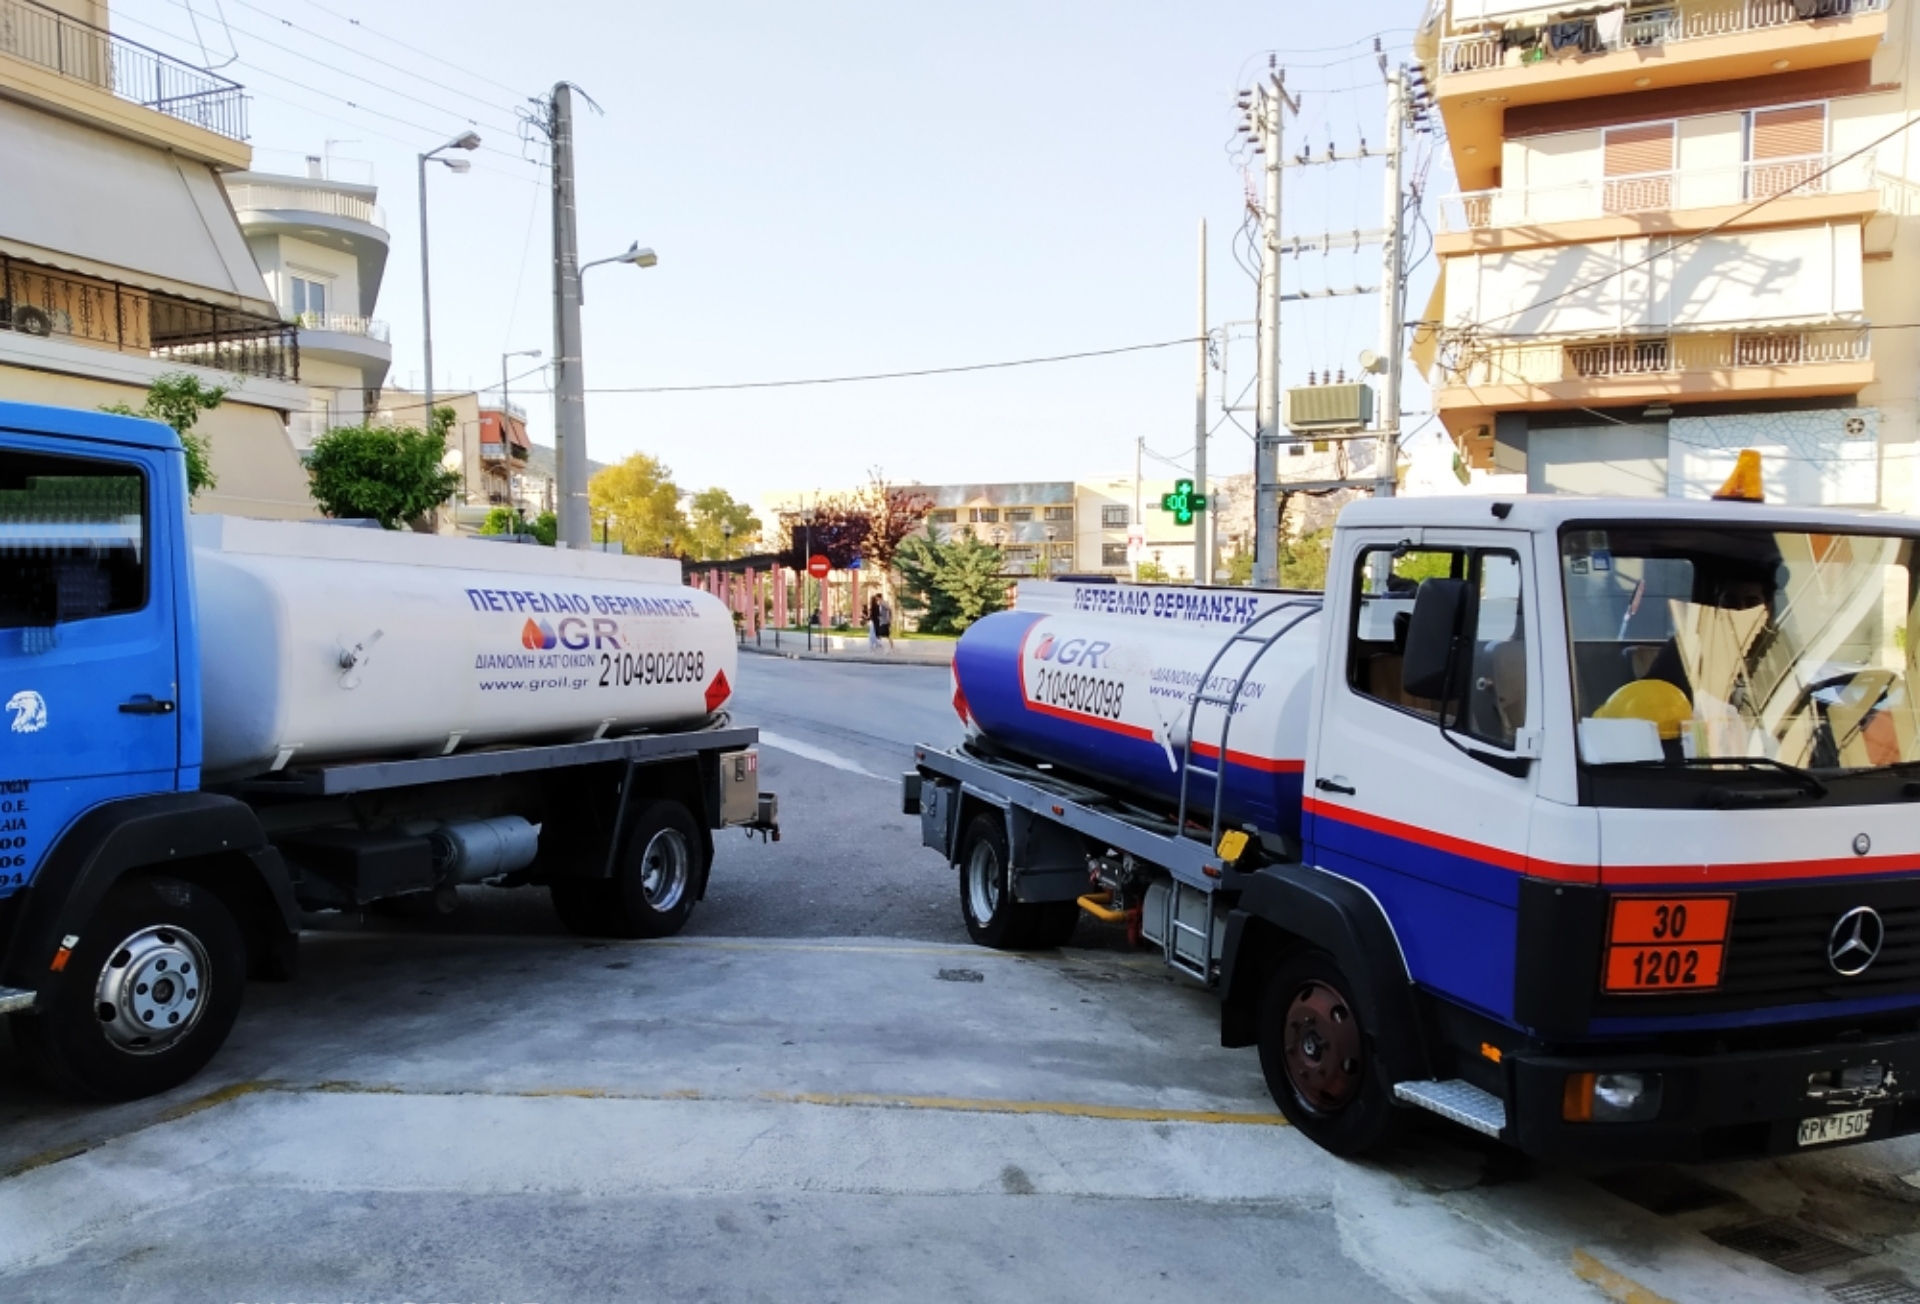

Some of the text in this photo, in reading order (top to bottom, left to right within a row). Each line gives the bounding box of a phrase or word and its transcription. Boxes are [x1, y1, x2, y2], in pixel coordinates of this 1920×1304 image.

[464, 589, 700, 618] ΠΕΤΡΕΛΑΙΟ ΘΕΡΜΑΝΣΗΣ
[1074, 587, 1259, 625] ΠΕΤΡΕΛΑΙΟ ΘΕΡΜΑΝΣΗΣ
[479, 676, 589, 692] www.groil.gr
[598, 650, 705, 687] 2104902098
[1035, 667, 1125, 719] 2104902098
[1652, 904, 1687, 939] 30
[1633, 950, 1698, 985] 1202
